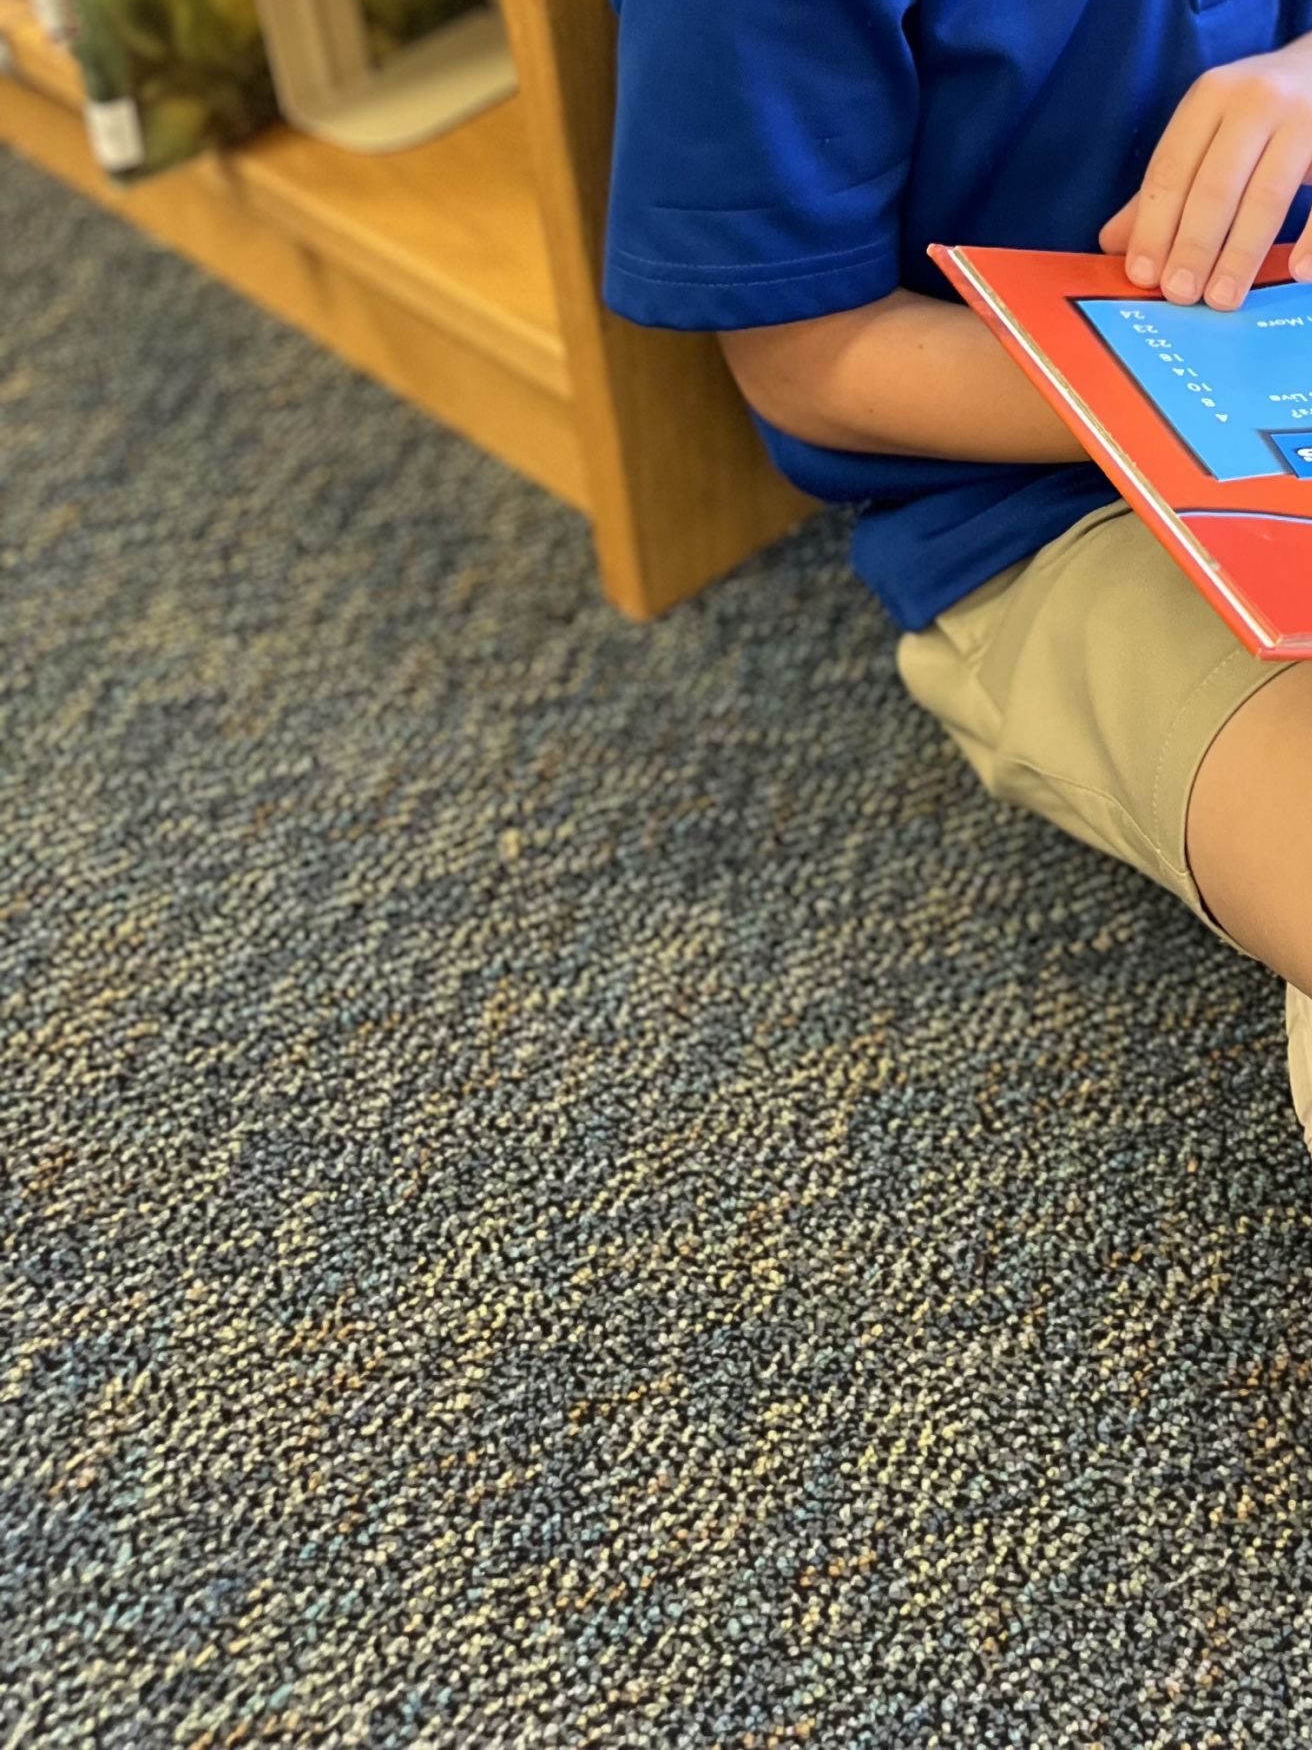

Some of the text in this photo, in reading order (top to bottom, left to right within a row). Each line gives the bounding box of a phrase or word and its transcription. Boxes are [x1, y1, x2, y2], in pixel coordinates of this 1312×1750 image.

[1119, 309, 1146, 320] 24
[1256, 316, 1305, 328] More
[1132, 322, 1159, 334] 23
[1145, 338, 1173, 349] 22
[1172, 367, 1199, 377] 14
[1186, 382, 1213, 393] 10
[1201, 397, 1216, 408] 8
[1268, 392, 1309, 402] Live
[1215, 412, 1229, 423] 4
